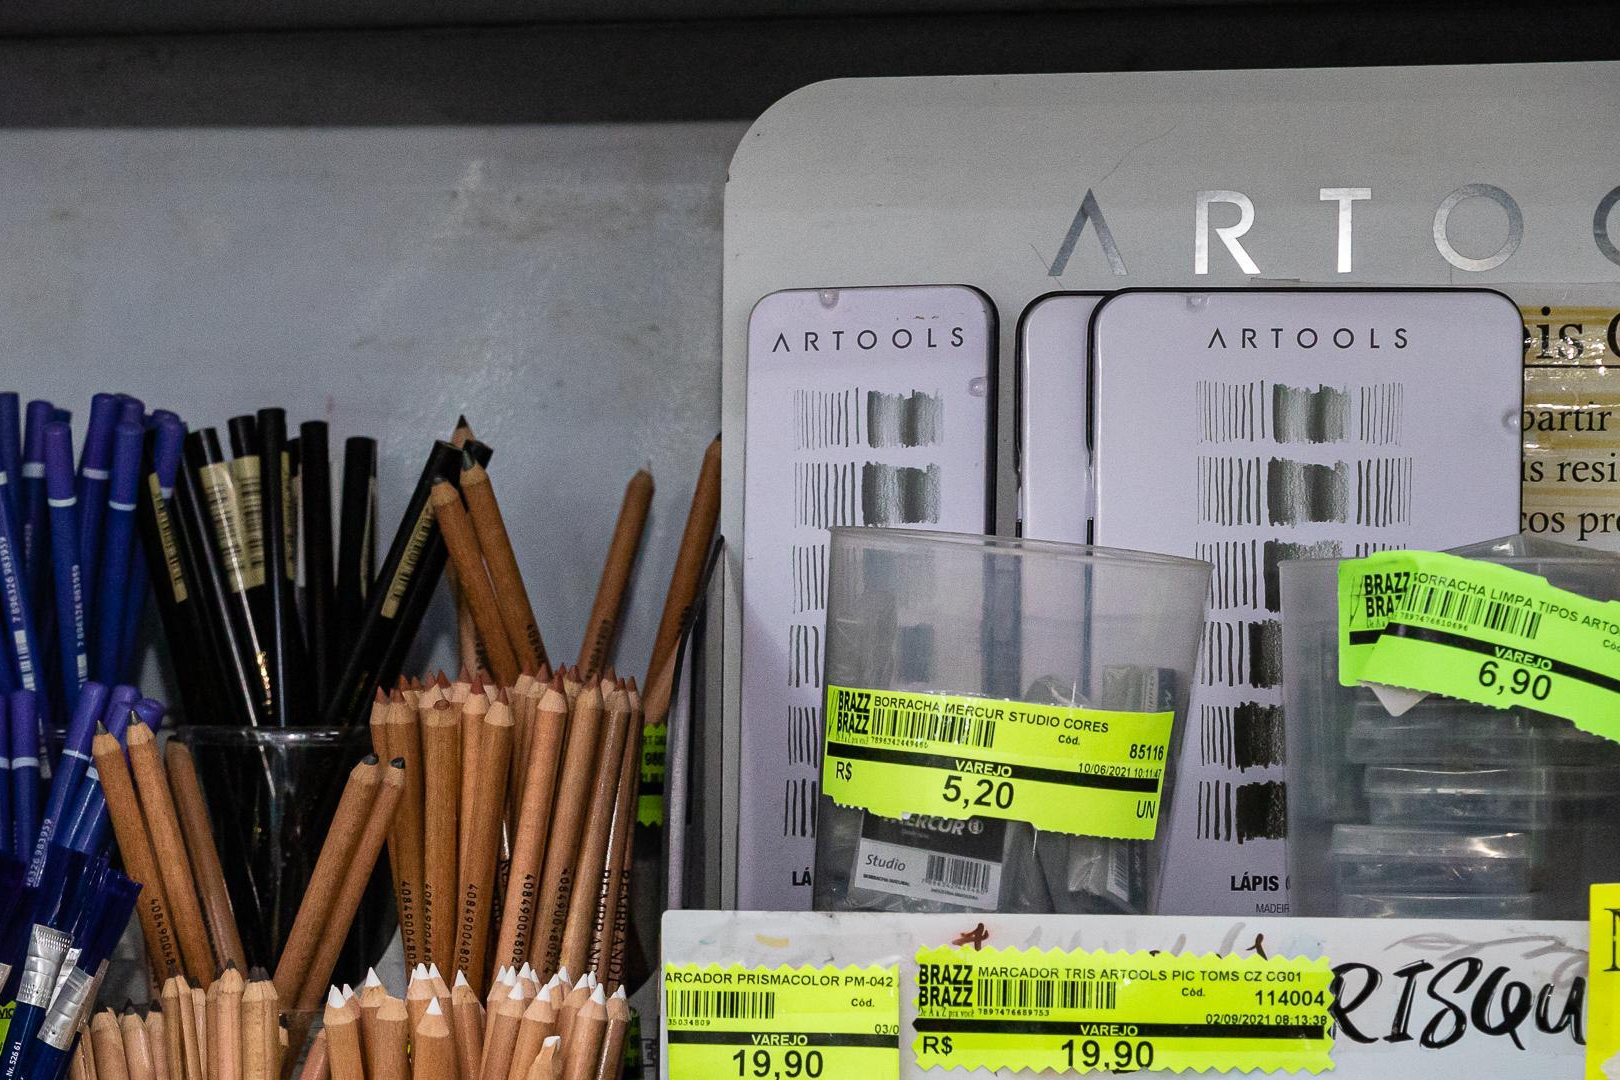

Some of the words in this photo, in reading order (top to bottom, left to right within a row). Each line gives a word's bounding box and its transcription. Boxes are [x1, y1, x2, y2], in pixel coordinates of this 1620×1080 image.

[772, 326, 966, 354] ARTOOLS
[1207, 326, 1411, 351] ARTOOLS
[1490, 590, 1533, 608] LIMPA
[1538, 600, 1585, 622] TIPOS
[1494, 646, 1553, 671] VAREJO
[1479, 660, 1552, 702] 6,90
[838, 690, 871, 713] BRAZZ
[874, 696, 940, 714] BORRACHA
[945, 703, 1003, 721] MERCUR
[1009, 711, 1059, 728] STUDIO
[1064, 717, 1109, 734] CORES
[837, 712, 870, 735] BRAZZ
[1129, 743, 1164, 761] 85116
[955, 759, 1012, 778] VAREJO
[1079, 762, 1131, 778] 10/06/2021
[835, 761, 853, 782] R$
[942, 775, 1014, 810] 5,20
[1136, 799, 1156, 819] UN
[865, 854, 906, 871] Studio
[1230, 871, 1279, 892] LÁPIS
[737, 974, 839, 987] PRISMACOLOR
[844, 976, 893, 988] PM-042
[919, 964, 973, 986] BRAZZ
[978, 966, 1060, 979] MARCADOR
[1065, 968, 1096, 980] TRIS
[1100, 969, 1168, 982] ARTOOLS
[1172, 970, 1196, 982] PIC
[1200, 971, 1240, 983] TOMS
[1244, 972, 1262, 983] CZ
[1266, 972, 1302, 983] CG01
[918, 985, 973, 1008] BRAZZ
[1255, 990, 1325, 1007] 114004
[1080, 1024, 1138, 1037] VAREJO
[1205, 1013, 1271, 1026] 02/09/2021
[751, 1033, 808, 1046] VAREJO
[923, 1036, 953, 1056] R$
